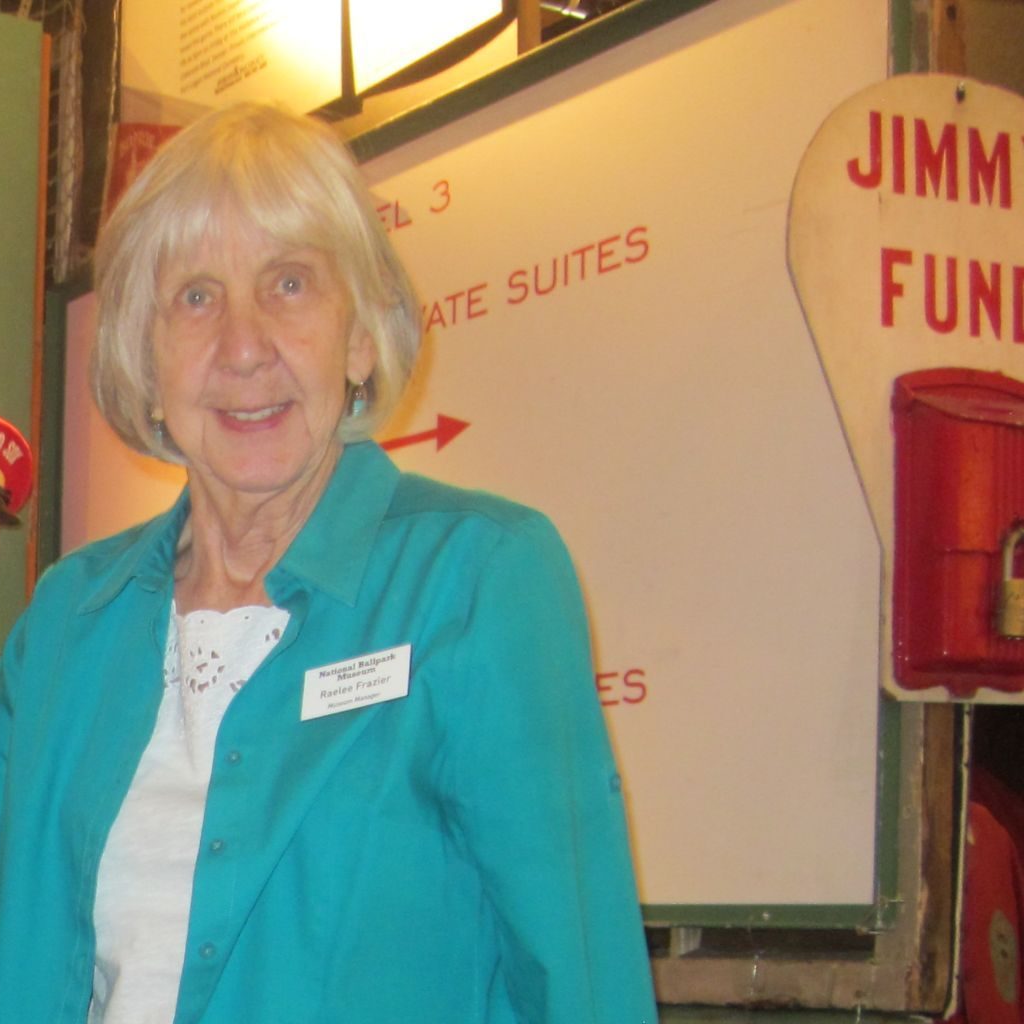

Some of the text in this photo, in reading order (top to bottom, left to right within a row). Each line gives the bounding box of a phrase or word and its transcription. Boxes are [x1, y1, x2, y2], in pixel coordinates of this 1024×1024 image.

[846, 110, 1024, 210] JIMM
[429, 179, 452, 214] 3
[506, 225, 650, 305] SUITES
[319, 653, 396, 679] National Ballpark
[337, 667, 376, 682] Museum
[320, 675, 392, 699] Raelee Frazier
